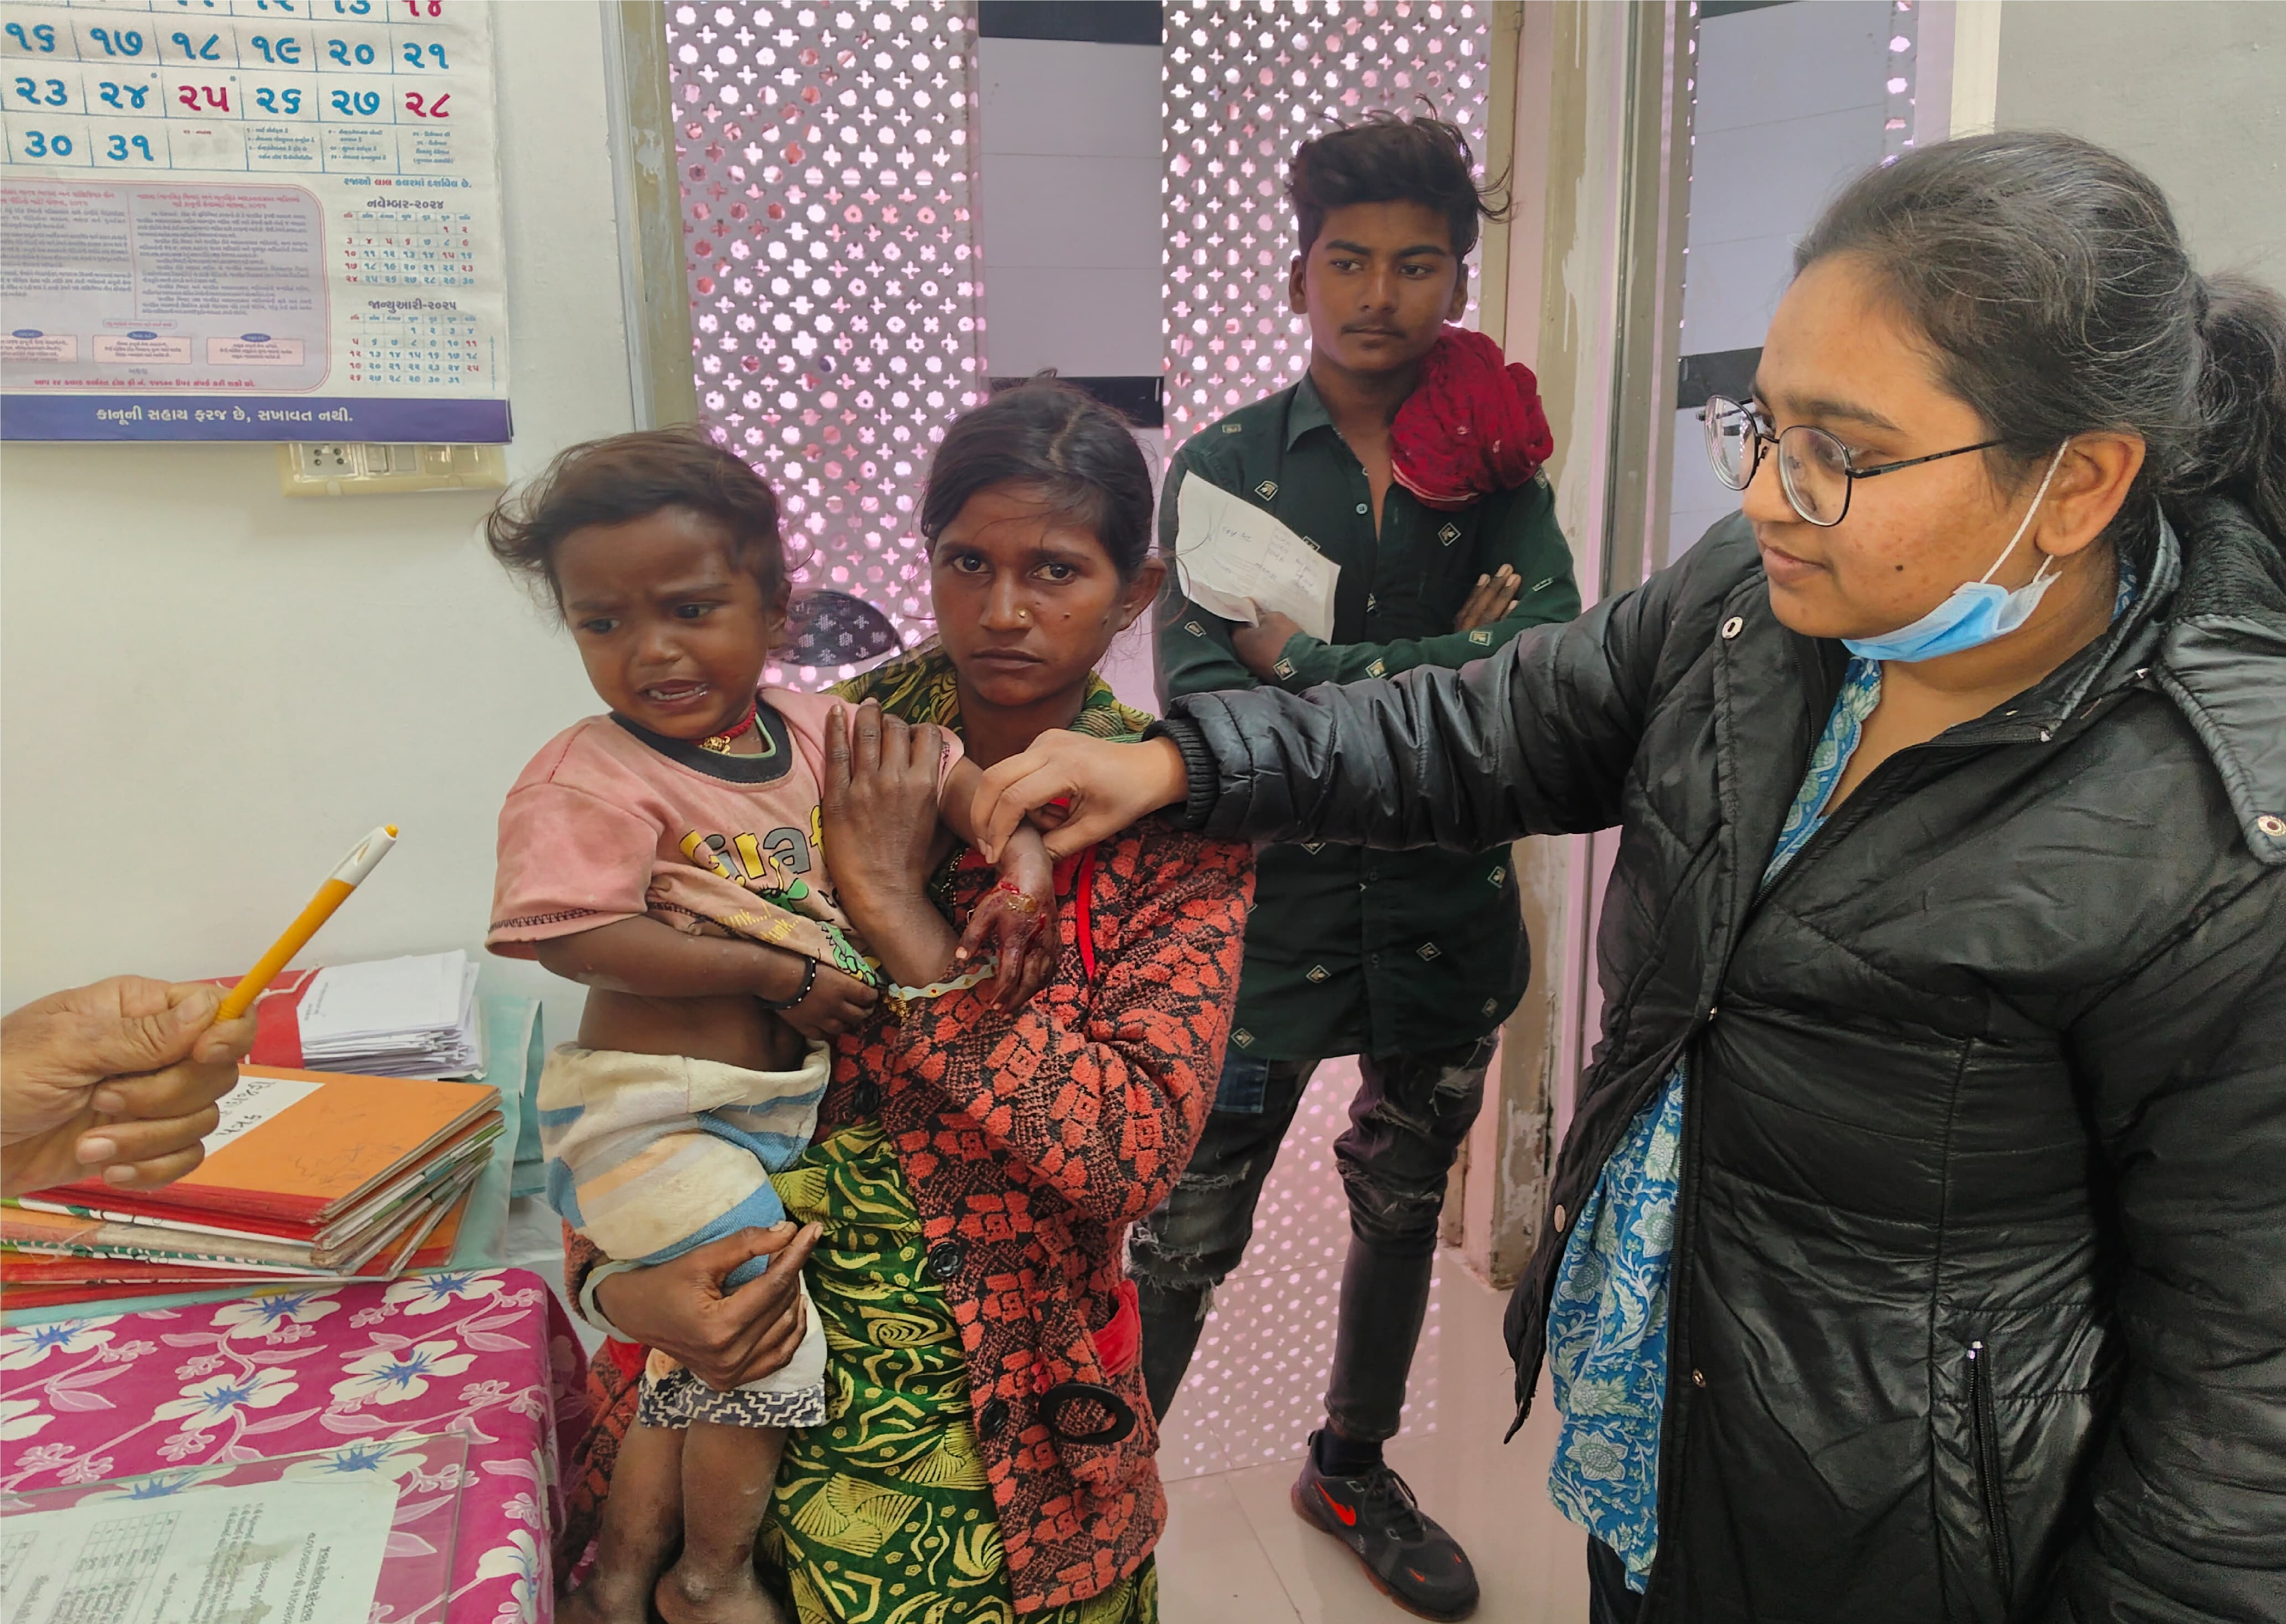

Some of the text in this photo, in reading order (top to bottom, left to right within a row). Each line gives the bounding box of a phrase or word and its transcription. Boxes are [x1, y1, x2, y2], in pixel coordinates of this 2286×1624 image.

[4, 22, 450, 70] ૧૬ ૧૭ ૧૮ ૧૯ ૨૦ ૨૧
[14, 76, 451, 118] ૨૩ ૨૪ ૨૫ ૨૬ ૨૭ ૨૮
[24, 130, 155, 162] ૩૦ ૩૧
[96, 405, 353, 425] કાનૂની સહાય ફરજ છે, સખાવત નથી.
